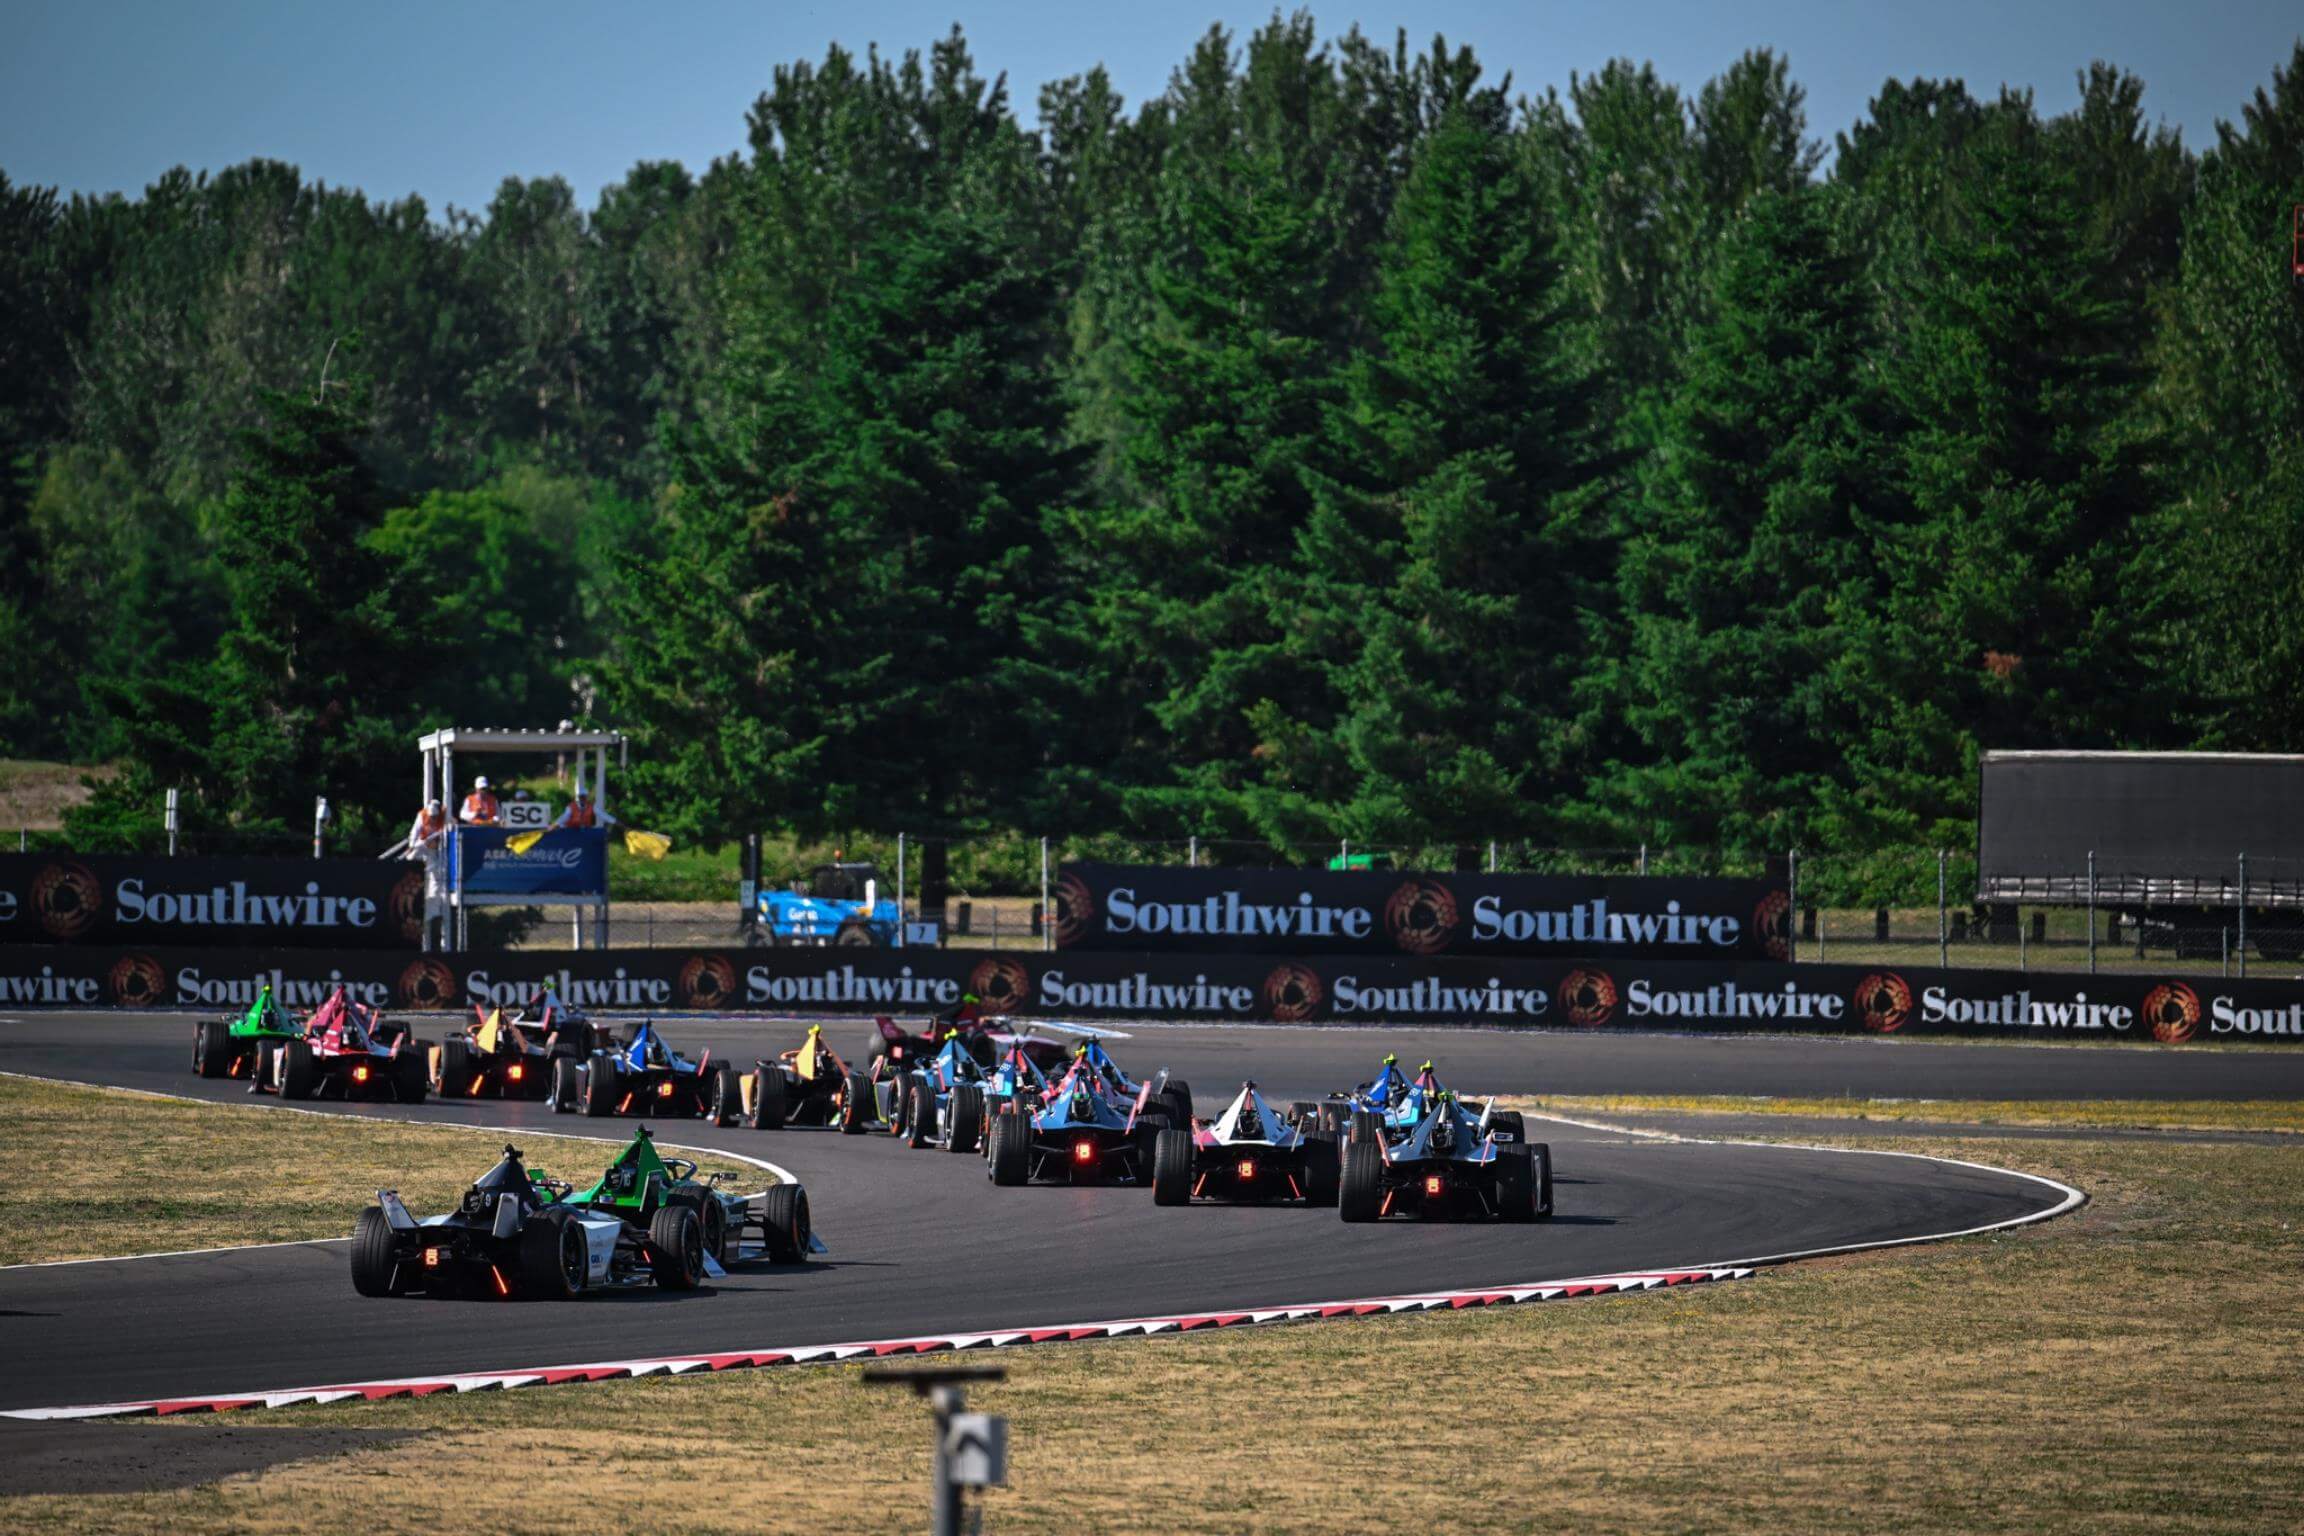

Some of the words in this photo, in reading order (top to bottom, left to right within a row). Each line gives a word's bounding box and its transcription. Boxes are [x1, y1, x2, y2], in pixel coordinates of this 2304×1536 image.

[510, 806, 543, 824] SC
[116, 878, 376, 926] Southwire
[1106, 888, 1371, 937] Southwire
[1472, 895, 1739, 945] Southwire
[466, 968, 671, 1006] Souhwire
[747, 965, 959, 1003] Southwire
[1040, 970, 1253, 1011] Southwire
[1333, 975, 1548, 1014] Southwire
[1627, 979, 1844, 1019] Southwire
[1921, 986, 2133, 1030] Southwire
